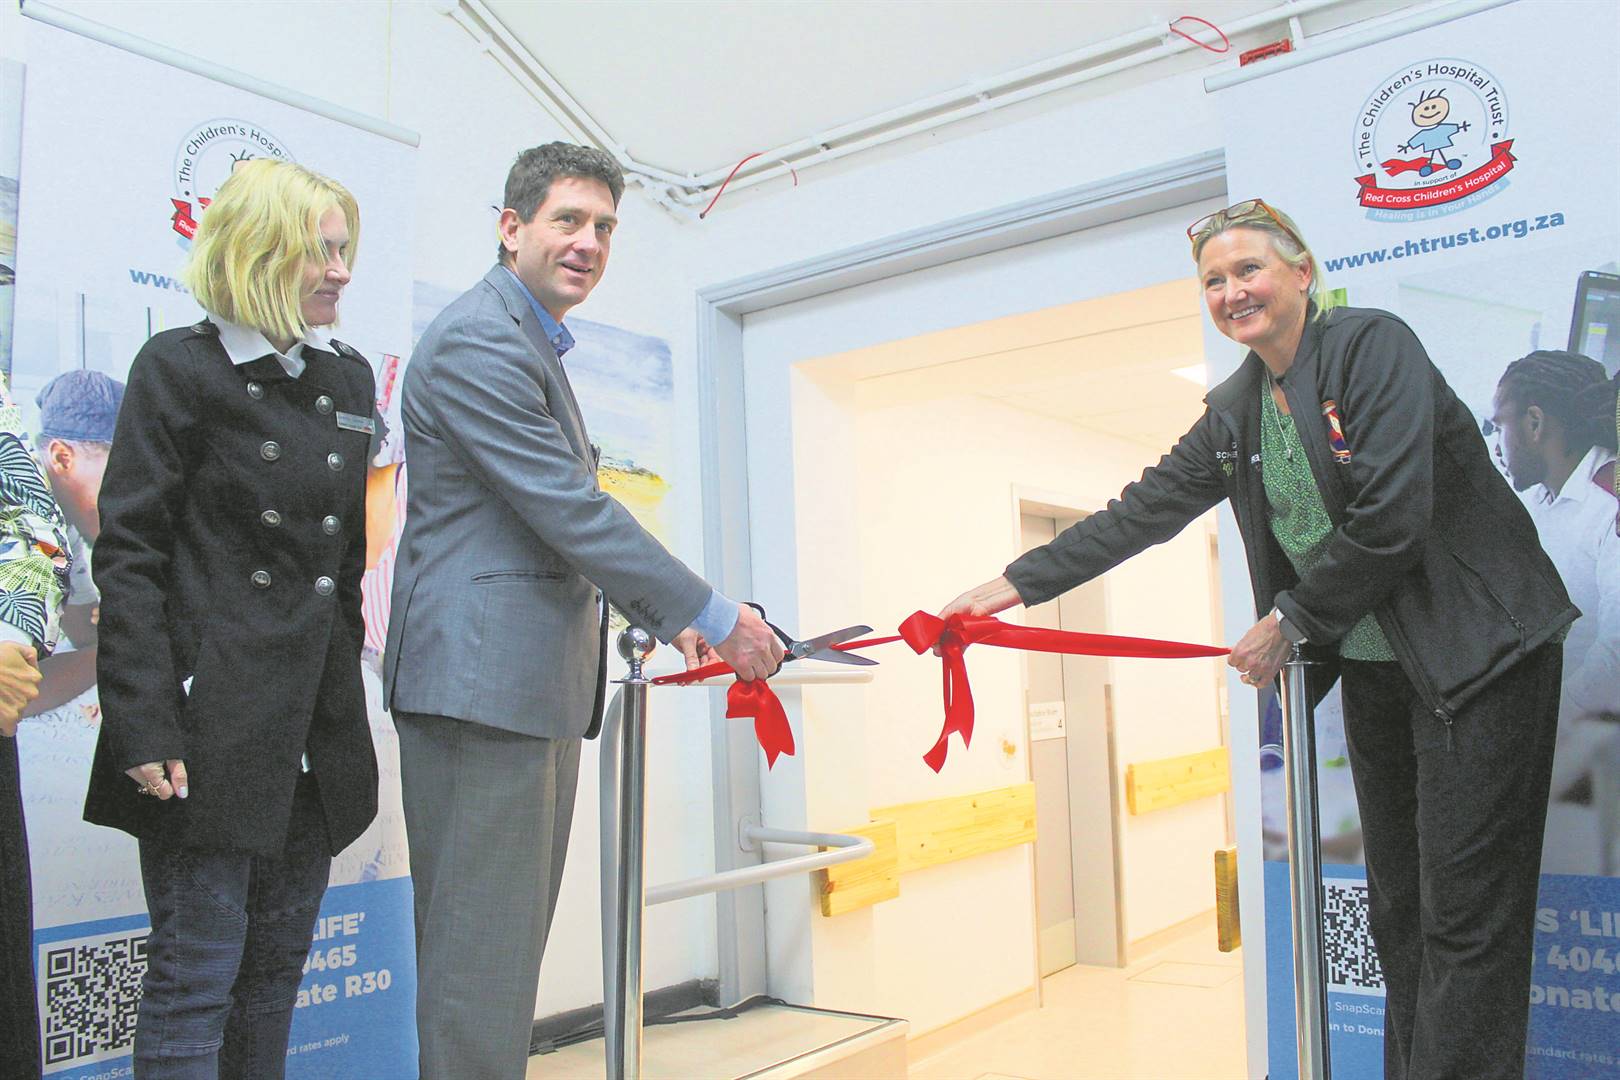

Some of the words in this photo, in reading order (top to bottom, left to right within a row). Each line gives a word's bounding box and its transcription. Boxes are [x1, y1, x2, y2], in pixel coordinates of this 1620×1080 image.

[1427, 63, 1490, 90] Hospital
[1362, 69, 1423, 127] Children's
[1485, 87, 1505, 126] Trust
[178, 158, 192, 183] The
[186, 125, 246, 156] Children's
[250, 129, 286, 160] Hosp
[1358, 131, 1371, 159] The
[1365, 193, 1384, 203] Red
[1385, 195, 1411, 203] Cross
[1413, 184, 1464, 202] Children's
[1464, 160, 1507, 189] Hospital
[1422, 174, 1449, 185] support
[1449, 171, 1457, 179] of
[1324, 211, 1565, 272] www.chtrust.org.za
[345, 969, 391, 997] R30
[1343, 1023, 1356, 1033] to
[299, 1041, 322, 1053] rates
[324, 1032, 350, 1048] apply
